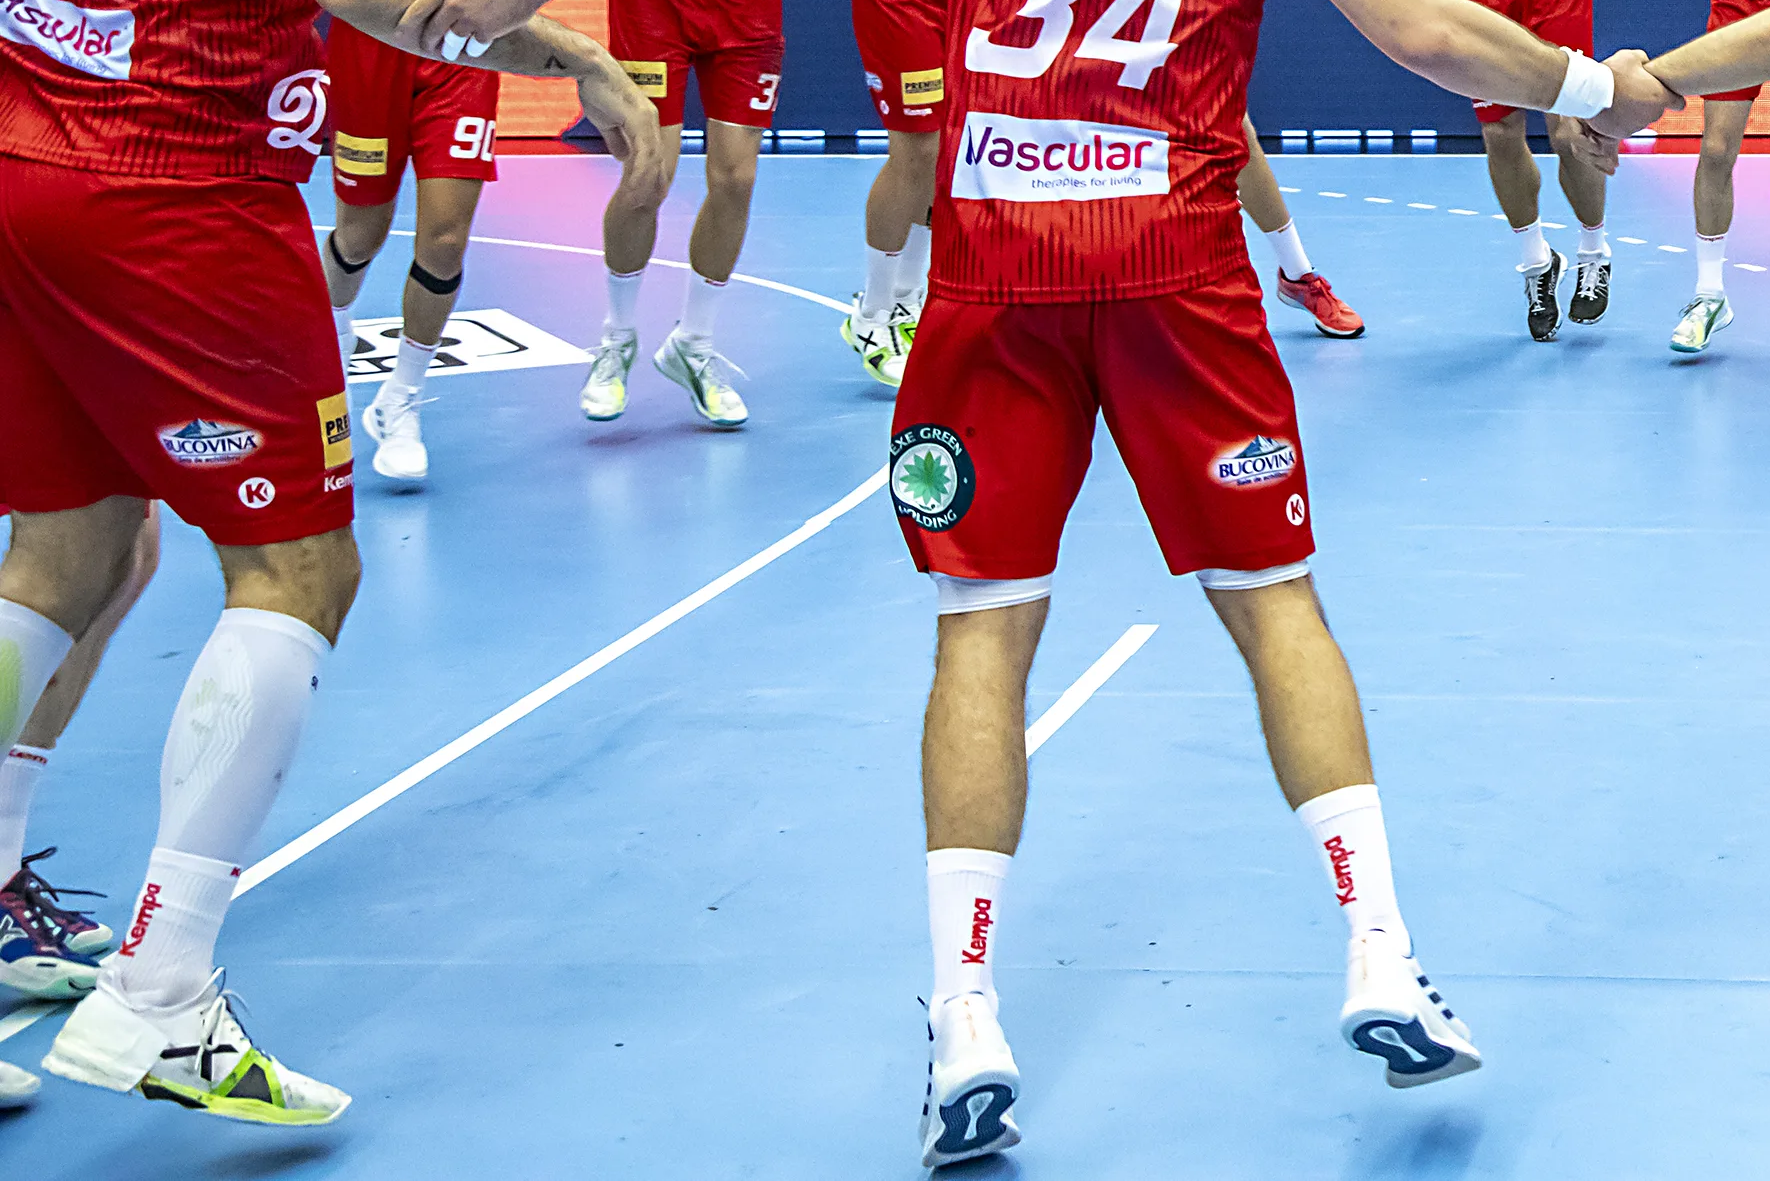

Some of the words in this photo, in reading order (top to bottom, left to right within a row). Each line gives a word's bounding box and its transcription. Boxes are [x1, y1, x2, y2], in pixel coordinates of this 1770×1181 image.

[751, 73, 781, 111] 3
[449, 116, 497, 162] 90
[1032, 178, 1087, 189] therapies
[1091, 177, 1106, 187] for
[1110, 176, 1142, 187] living
[163, 433, 258, 455] BUCOVINA
[890, 431, 917, 456] EXE
[919, 427, 963, 457] GREEN
[1219, 450, 1296, 479] BUCOVINA
[1323, 835, 1357, 907] Kempa
[119, 882, 163, 958] Kempa
[962, 897, 992, 965] Kempa
